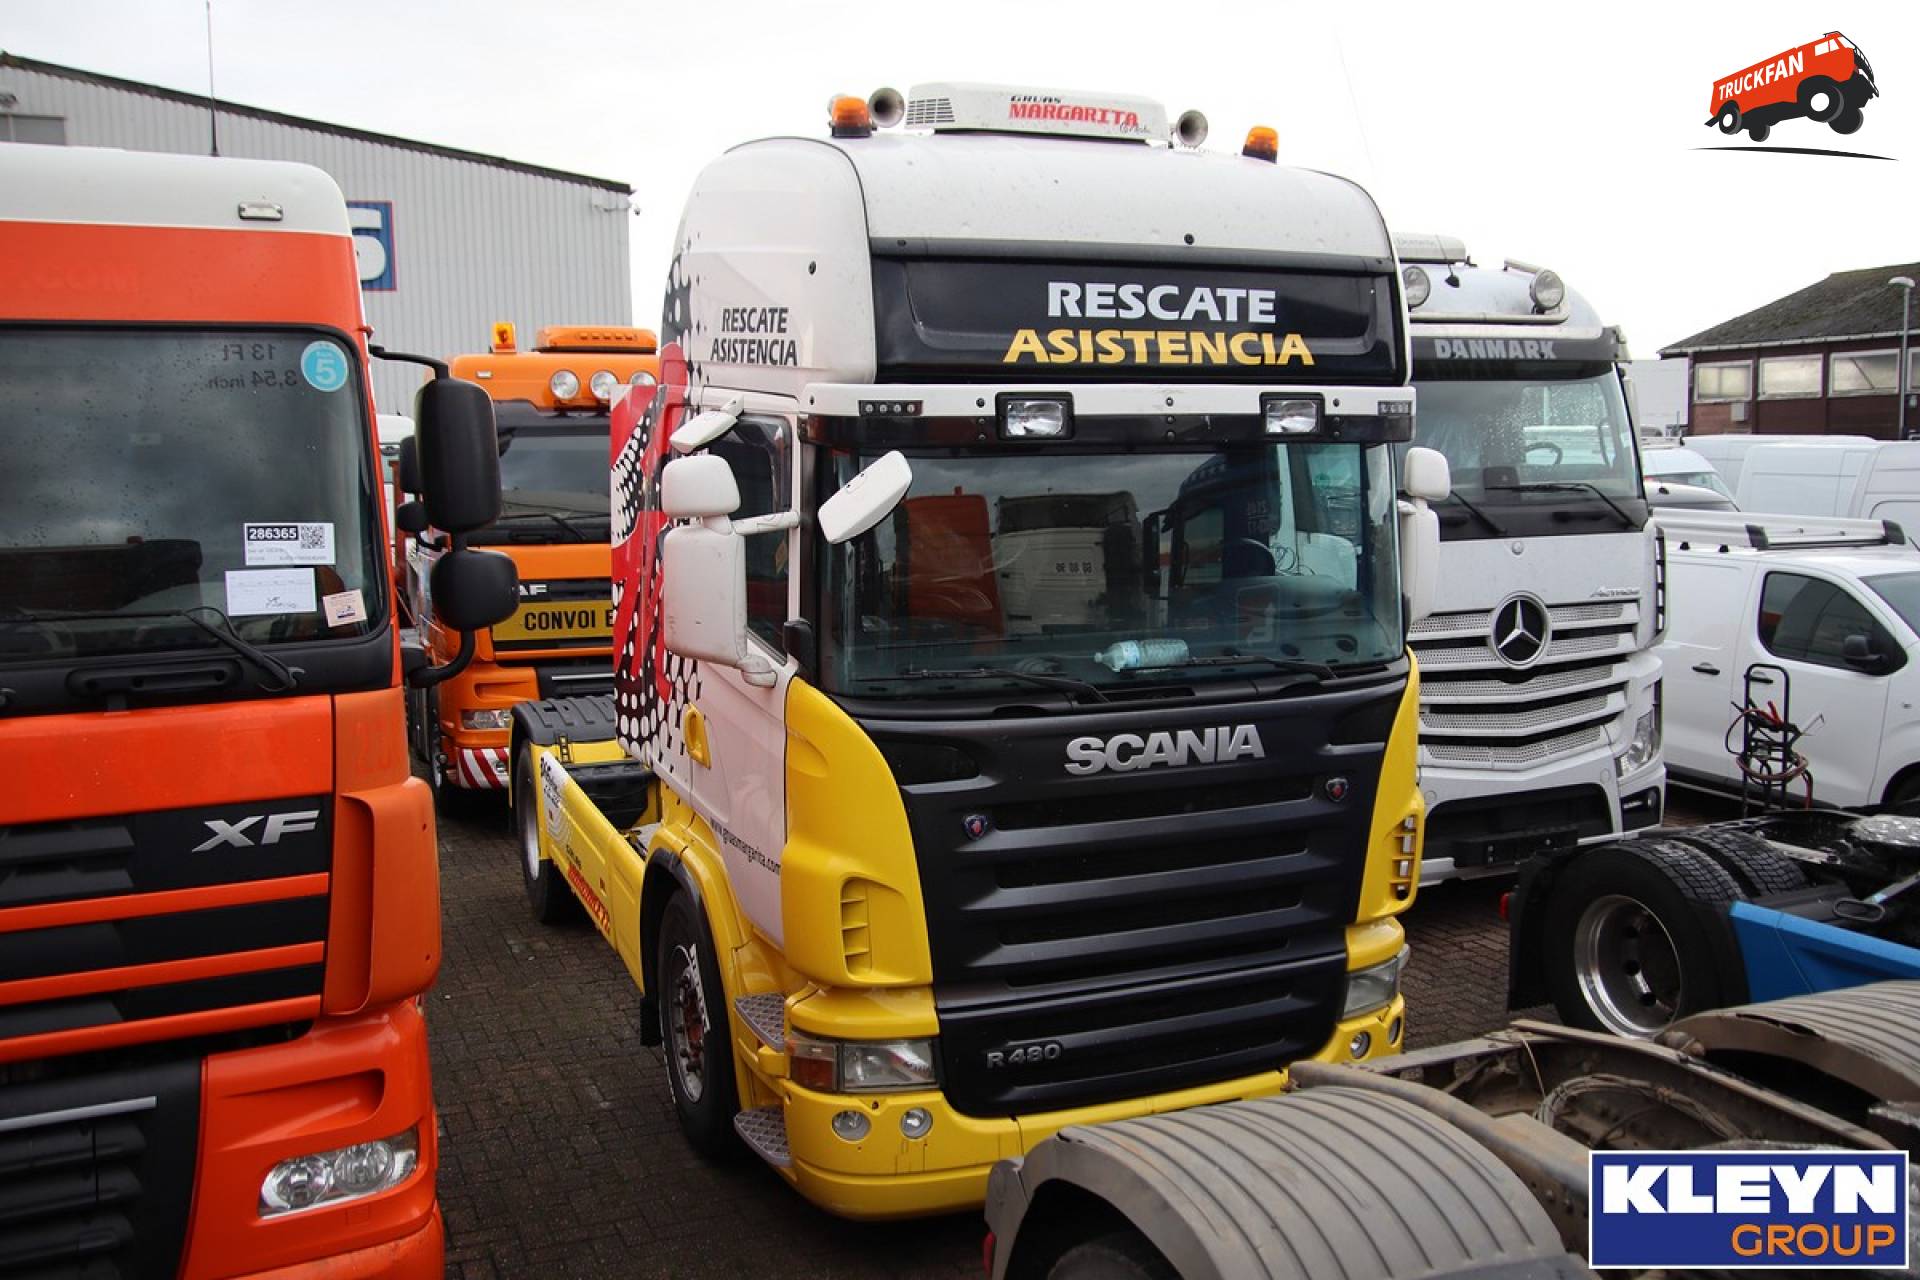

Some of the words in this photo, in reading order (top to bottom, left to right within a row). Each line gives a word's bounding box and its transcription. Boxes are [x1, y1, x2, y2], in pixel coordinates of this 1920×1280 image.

[1009, 103, 1139, 127] MARGARITA
[1047, 281, 1277, 324] RESCATE
[721, 306, 790, 334] RESCATE
[710, 337, 798, 366] ASISTENCIA
[1003, 328, 1315, 366] ASISTENCIA
[1434, 338, 1557, 360] DANMARK
[315, 357, 337, 385] 5
[248, 527, 297, 541] 286365
[524, 609, 597, 631] CONVOI
[1064, 724, 1266, 775] SCANIA
[191, 809, 320, 853] XF
[987, 1051, 1005, 1069] R
[1008, 1043, 1061, 1064] 480
